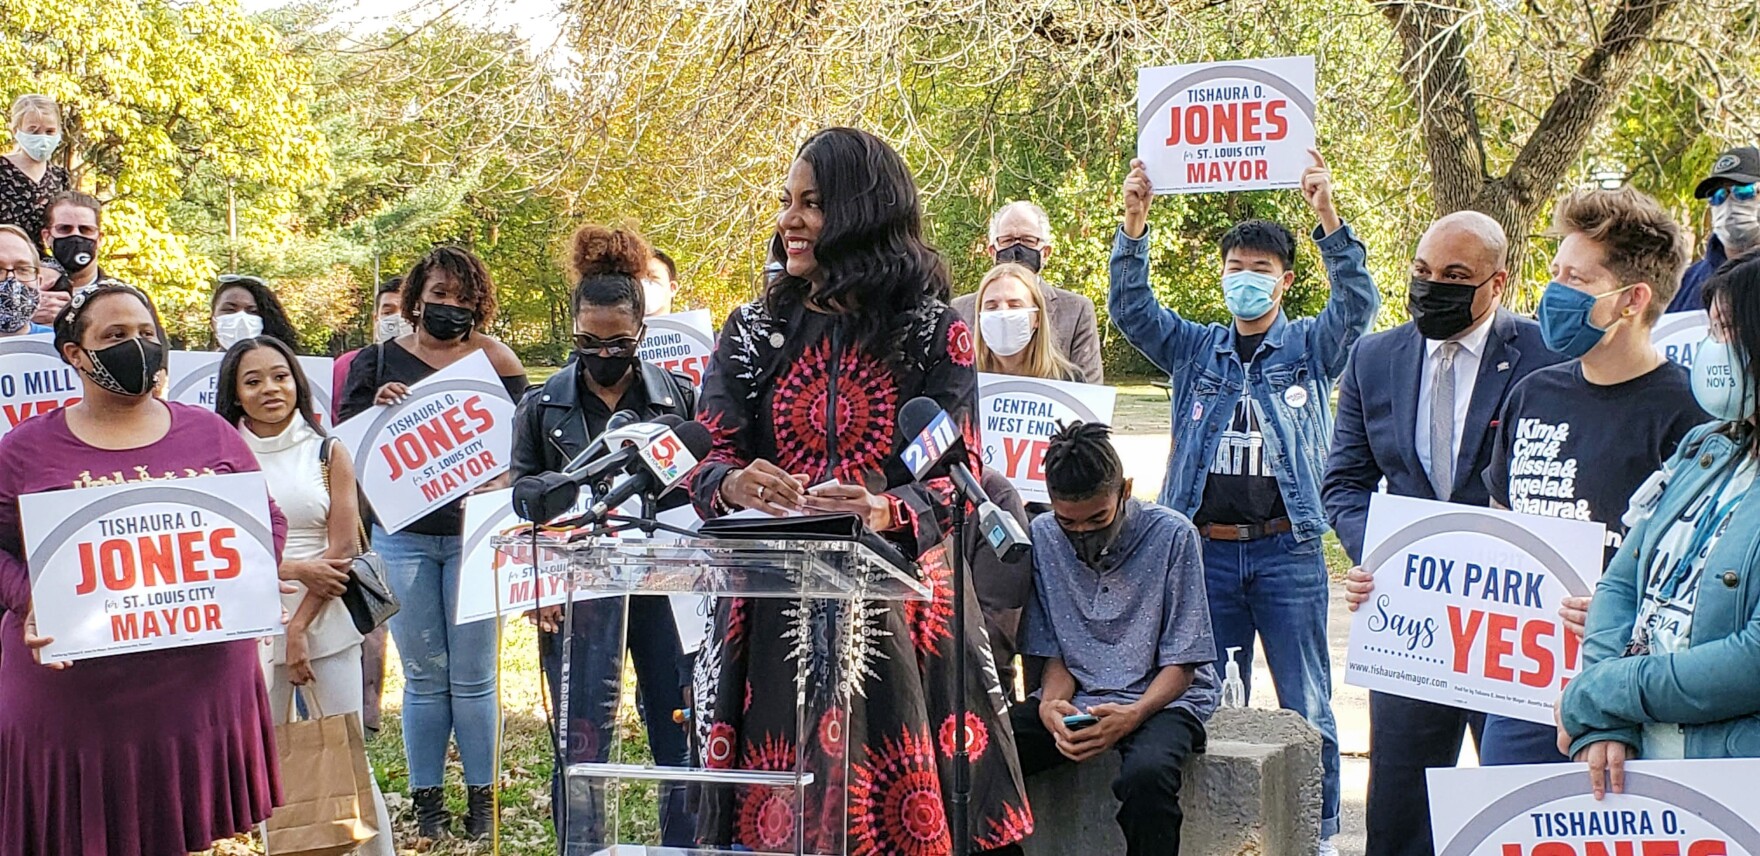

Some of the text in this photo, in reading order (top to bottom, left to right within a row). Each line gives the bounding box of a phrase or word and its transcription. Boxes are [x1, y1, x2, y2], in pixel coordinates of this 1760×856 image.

[1187, 85, 1266, 103] TISHAURA O.
[1166, 99, 1288, 147] JONES
[1197, 149, 1212, 159] ST.
[1215, 146, 1242, 158] LOUIS
[1245, 145, 1266, 156] CITY
[1187, 159, 1268, 184] MAYOR
[638, 333, 682, 349] GROUND
[24, 368, 76, 395] MILL
[1706, 365, 1730, 376] VOTE
[1706, 377, 1736, 388] NOV 3
[386, 393, 459, 437] TISHAURA O.
[993, 397, 1054, 418] CENTRAL
[379, 395, 495, 482] JONES
[987, 416, 1055, 437] WEST END
[423, 466, 439, 478] ST.
[438, 450, 465, 470] LOUIS
[464, 438, 484, 455] CITY
[905, 443, 929, 474] 2
[931, 416, 956, 455] 11
[1003, 437, 1050, 480] YE
[1210, 437, 1277, 476] ATT
[420, 450, 498, 503] MAYOR
[98, 510, 208, 537] TISHAURA O.
[75, 527, 242, 596] JONES
[1403, 553, 1545, 609] FOX PARK
[123, 595, 145, 609] ST.
[147, 590, 185, 606] LOUIS
[188, 586, 216, 602] CITY
[111, 603, 223, 642] MAYOR
[1367, 594, 1581, 692] Says YES!
[1348, 661, 1448, 688] www.tishaura4mayor.com
[1530, 810, 1686, 838] TISHAURA O.
